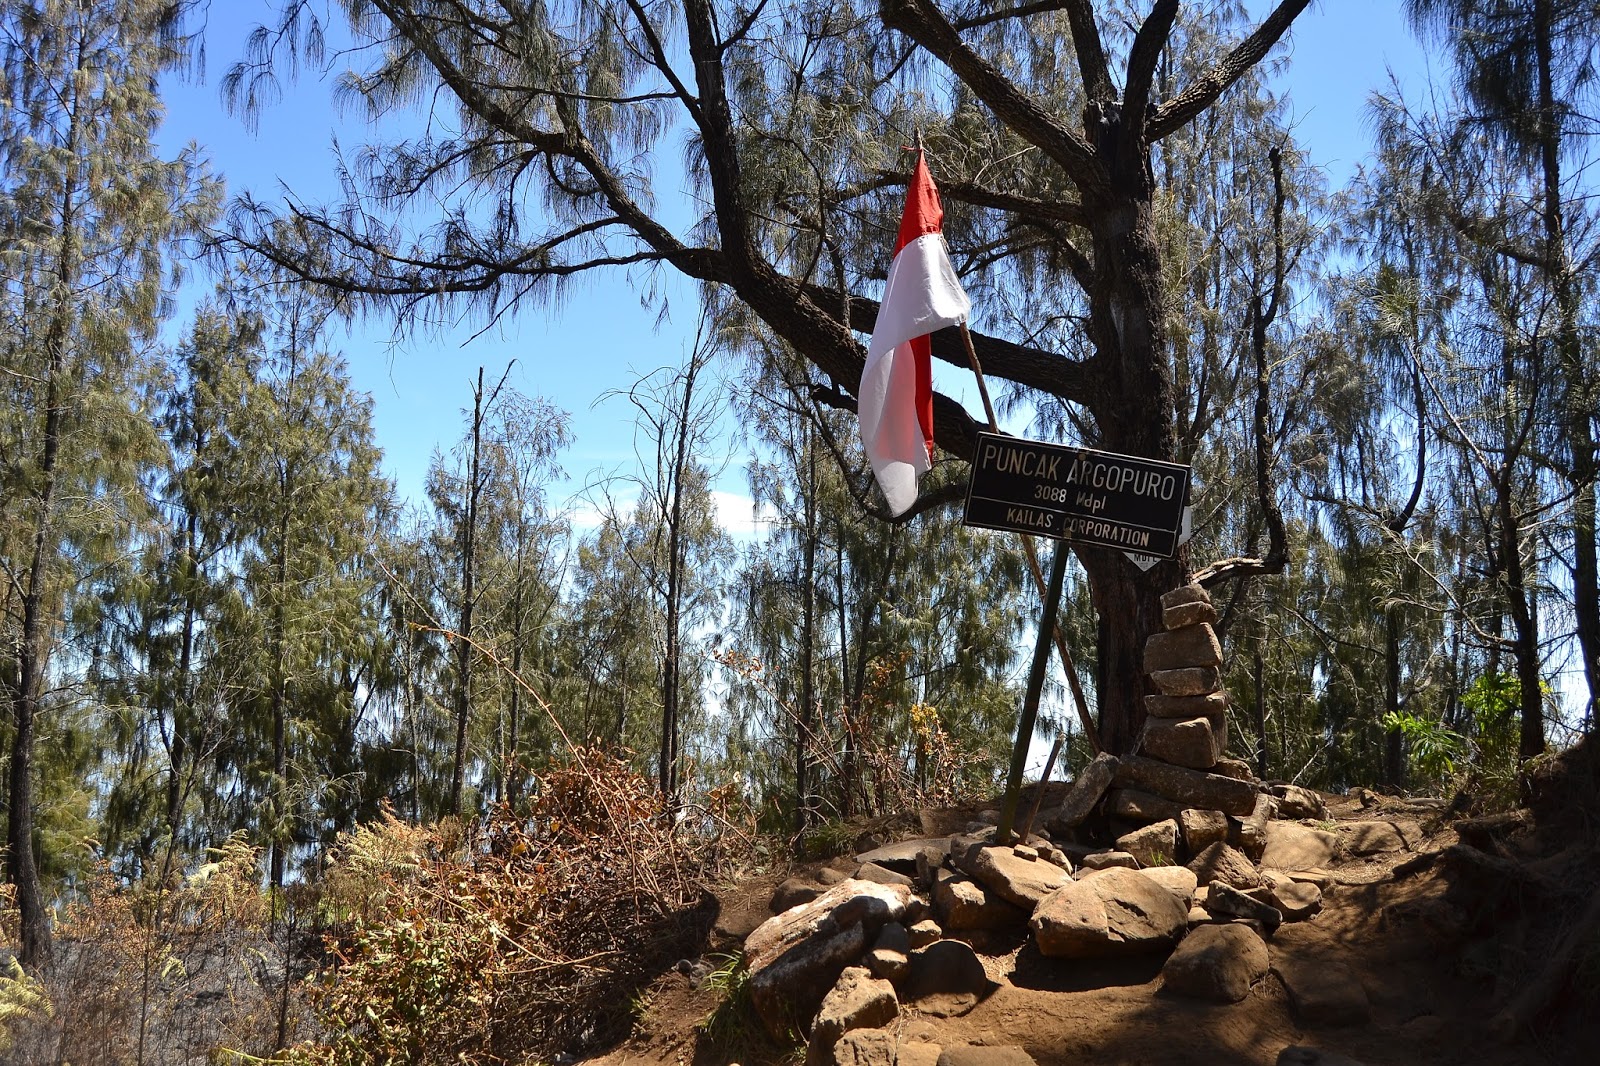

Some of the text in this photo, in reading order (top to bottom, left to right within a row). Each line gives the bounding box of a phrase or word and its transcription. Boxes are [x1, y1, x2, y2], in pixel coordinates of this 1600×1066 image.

[983, 444, 1175, 501] PUNCAK ARGOPURO
[1034, 485, 1106, 514] 3088 Mdpl
[1006, 508, 1149, 547] KAILAS CORPORATION
